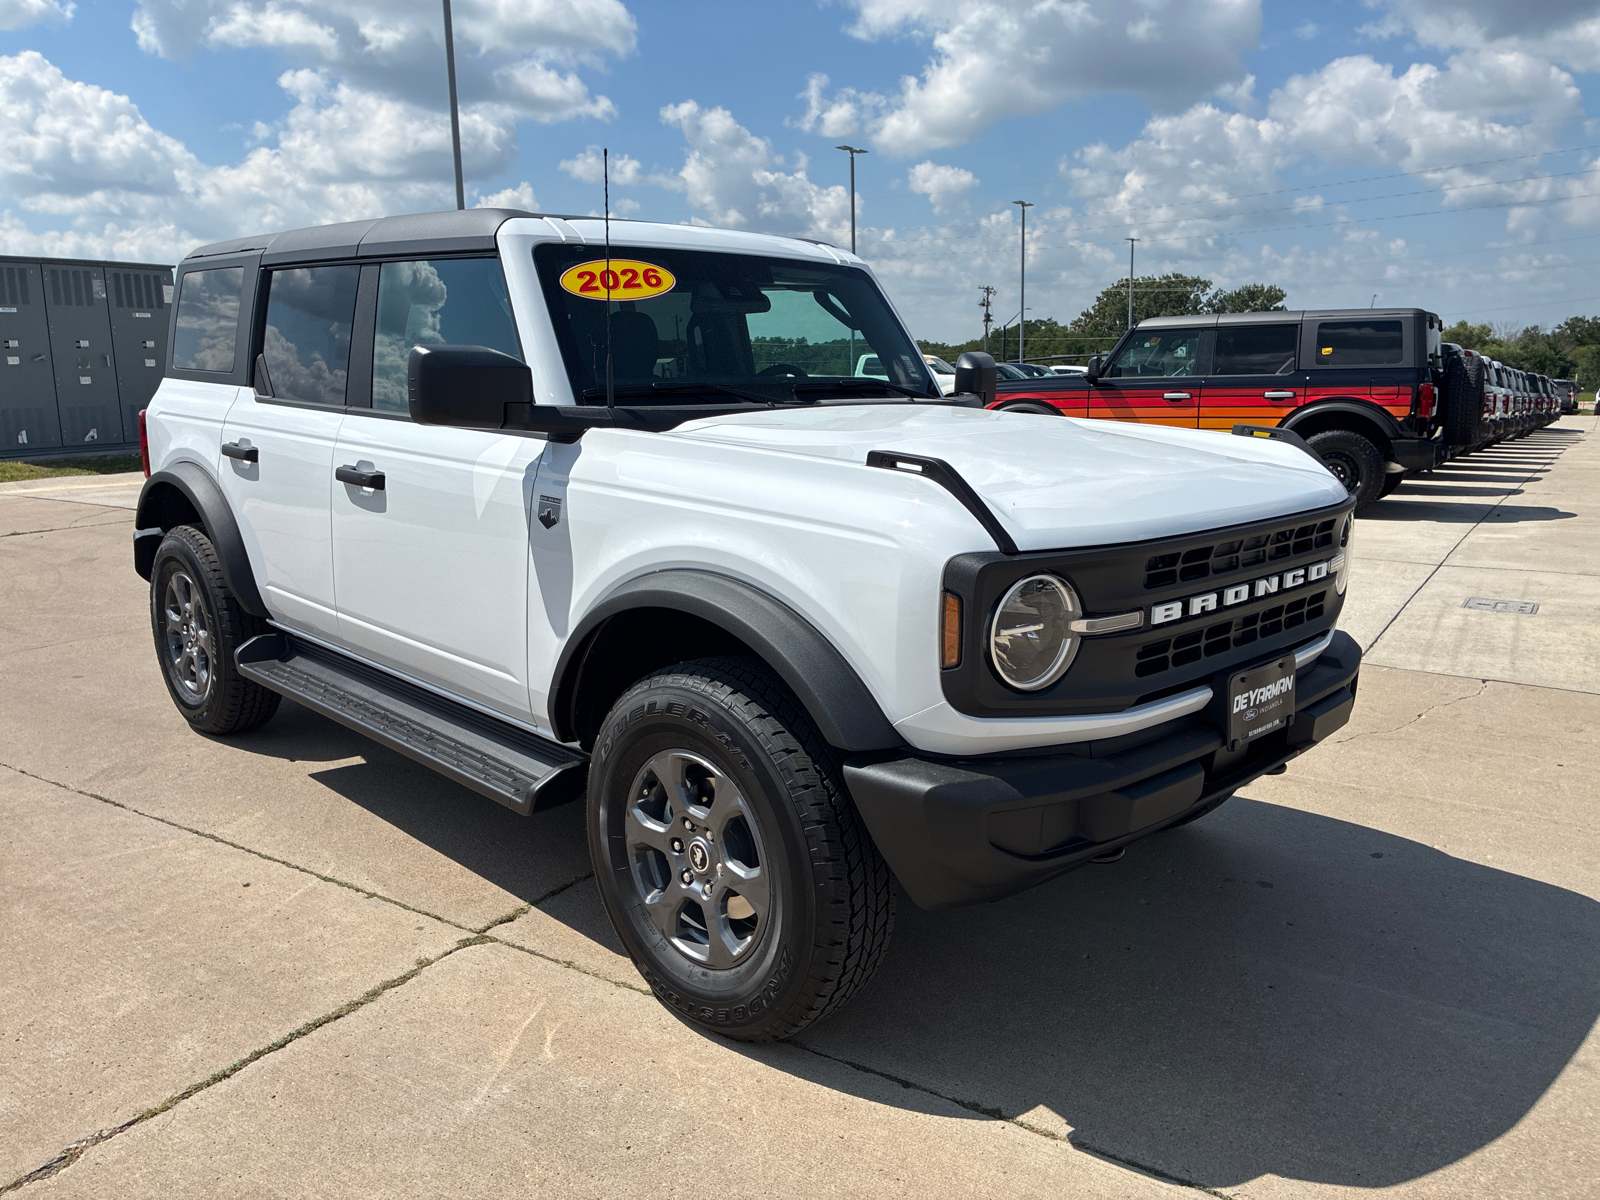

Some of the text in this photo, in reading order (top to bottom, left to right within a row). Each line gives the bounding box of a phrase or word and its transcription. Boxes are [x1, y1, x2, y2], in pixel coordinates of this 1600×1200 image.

[577, 268, 663, 293] 2026
[1150, 561, 1329, 625] BRONCO
[1233, 675, 1294, 714] DEYARMAN
[1244, 699, 1283, 720] Ford INDIANOLA
[600, 699, 755, 773] DUELER A/T
[637, 943, 794, 1025] BRIDGESTONE
